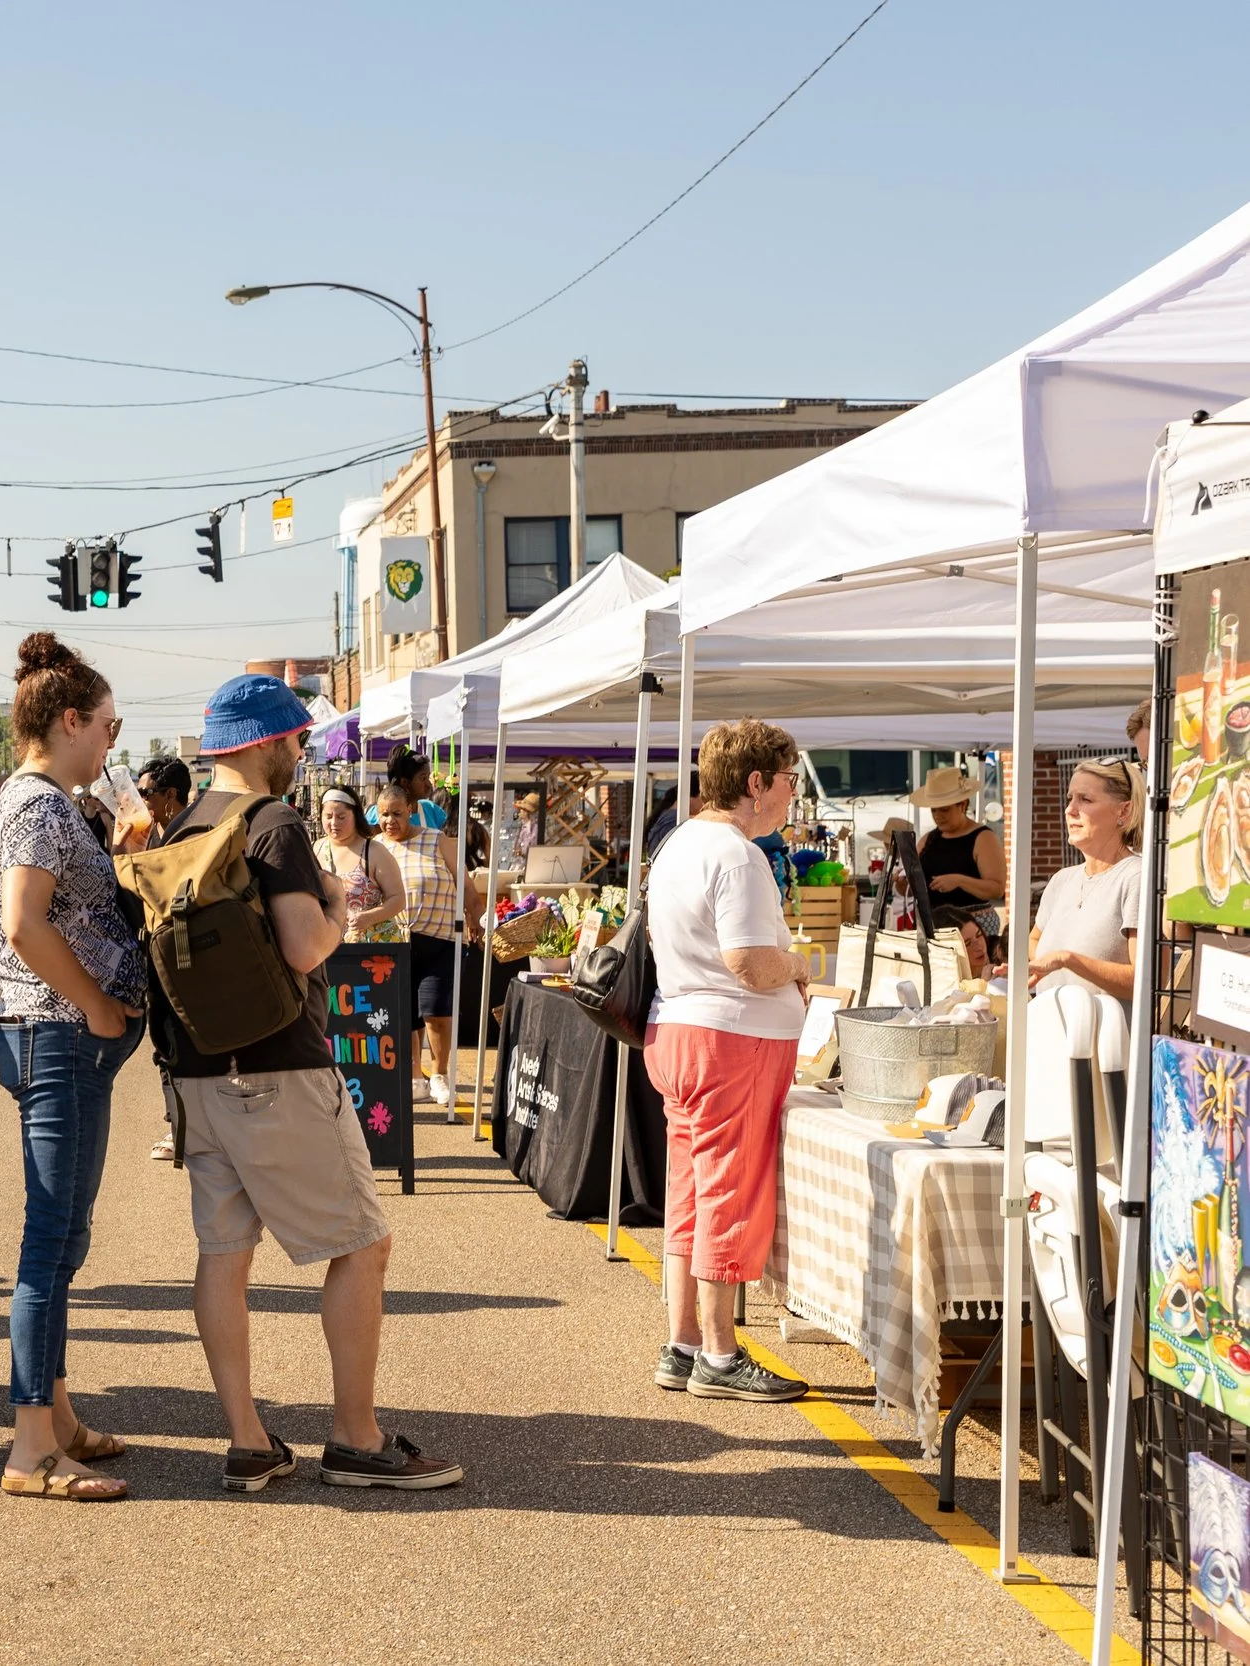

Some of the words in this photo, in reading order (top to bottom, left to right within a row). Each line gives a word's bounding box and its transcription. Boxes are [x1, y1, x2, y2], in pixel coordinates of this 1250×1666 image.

[1213, 480, 1239, 497] OZARK
[328, 984, 372, 1016] ACE
[324, 1032, 396, 1070] INTING
[520, 1052, 540, 1077] Aved
[346, 1078, 364, 1110] 3
